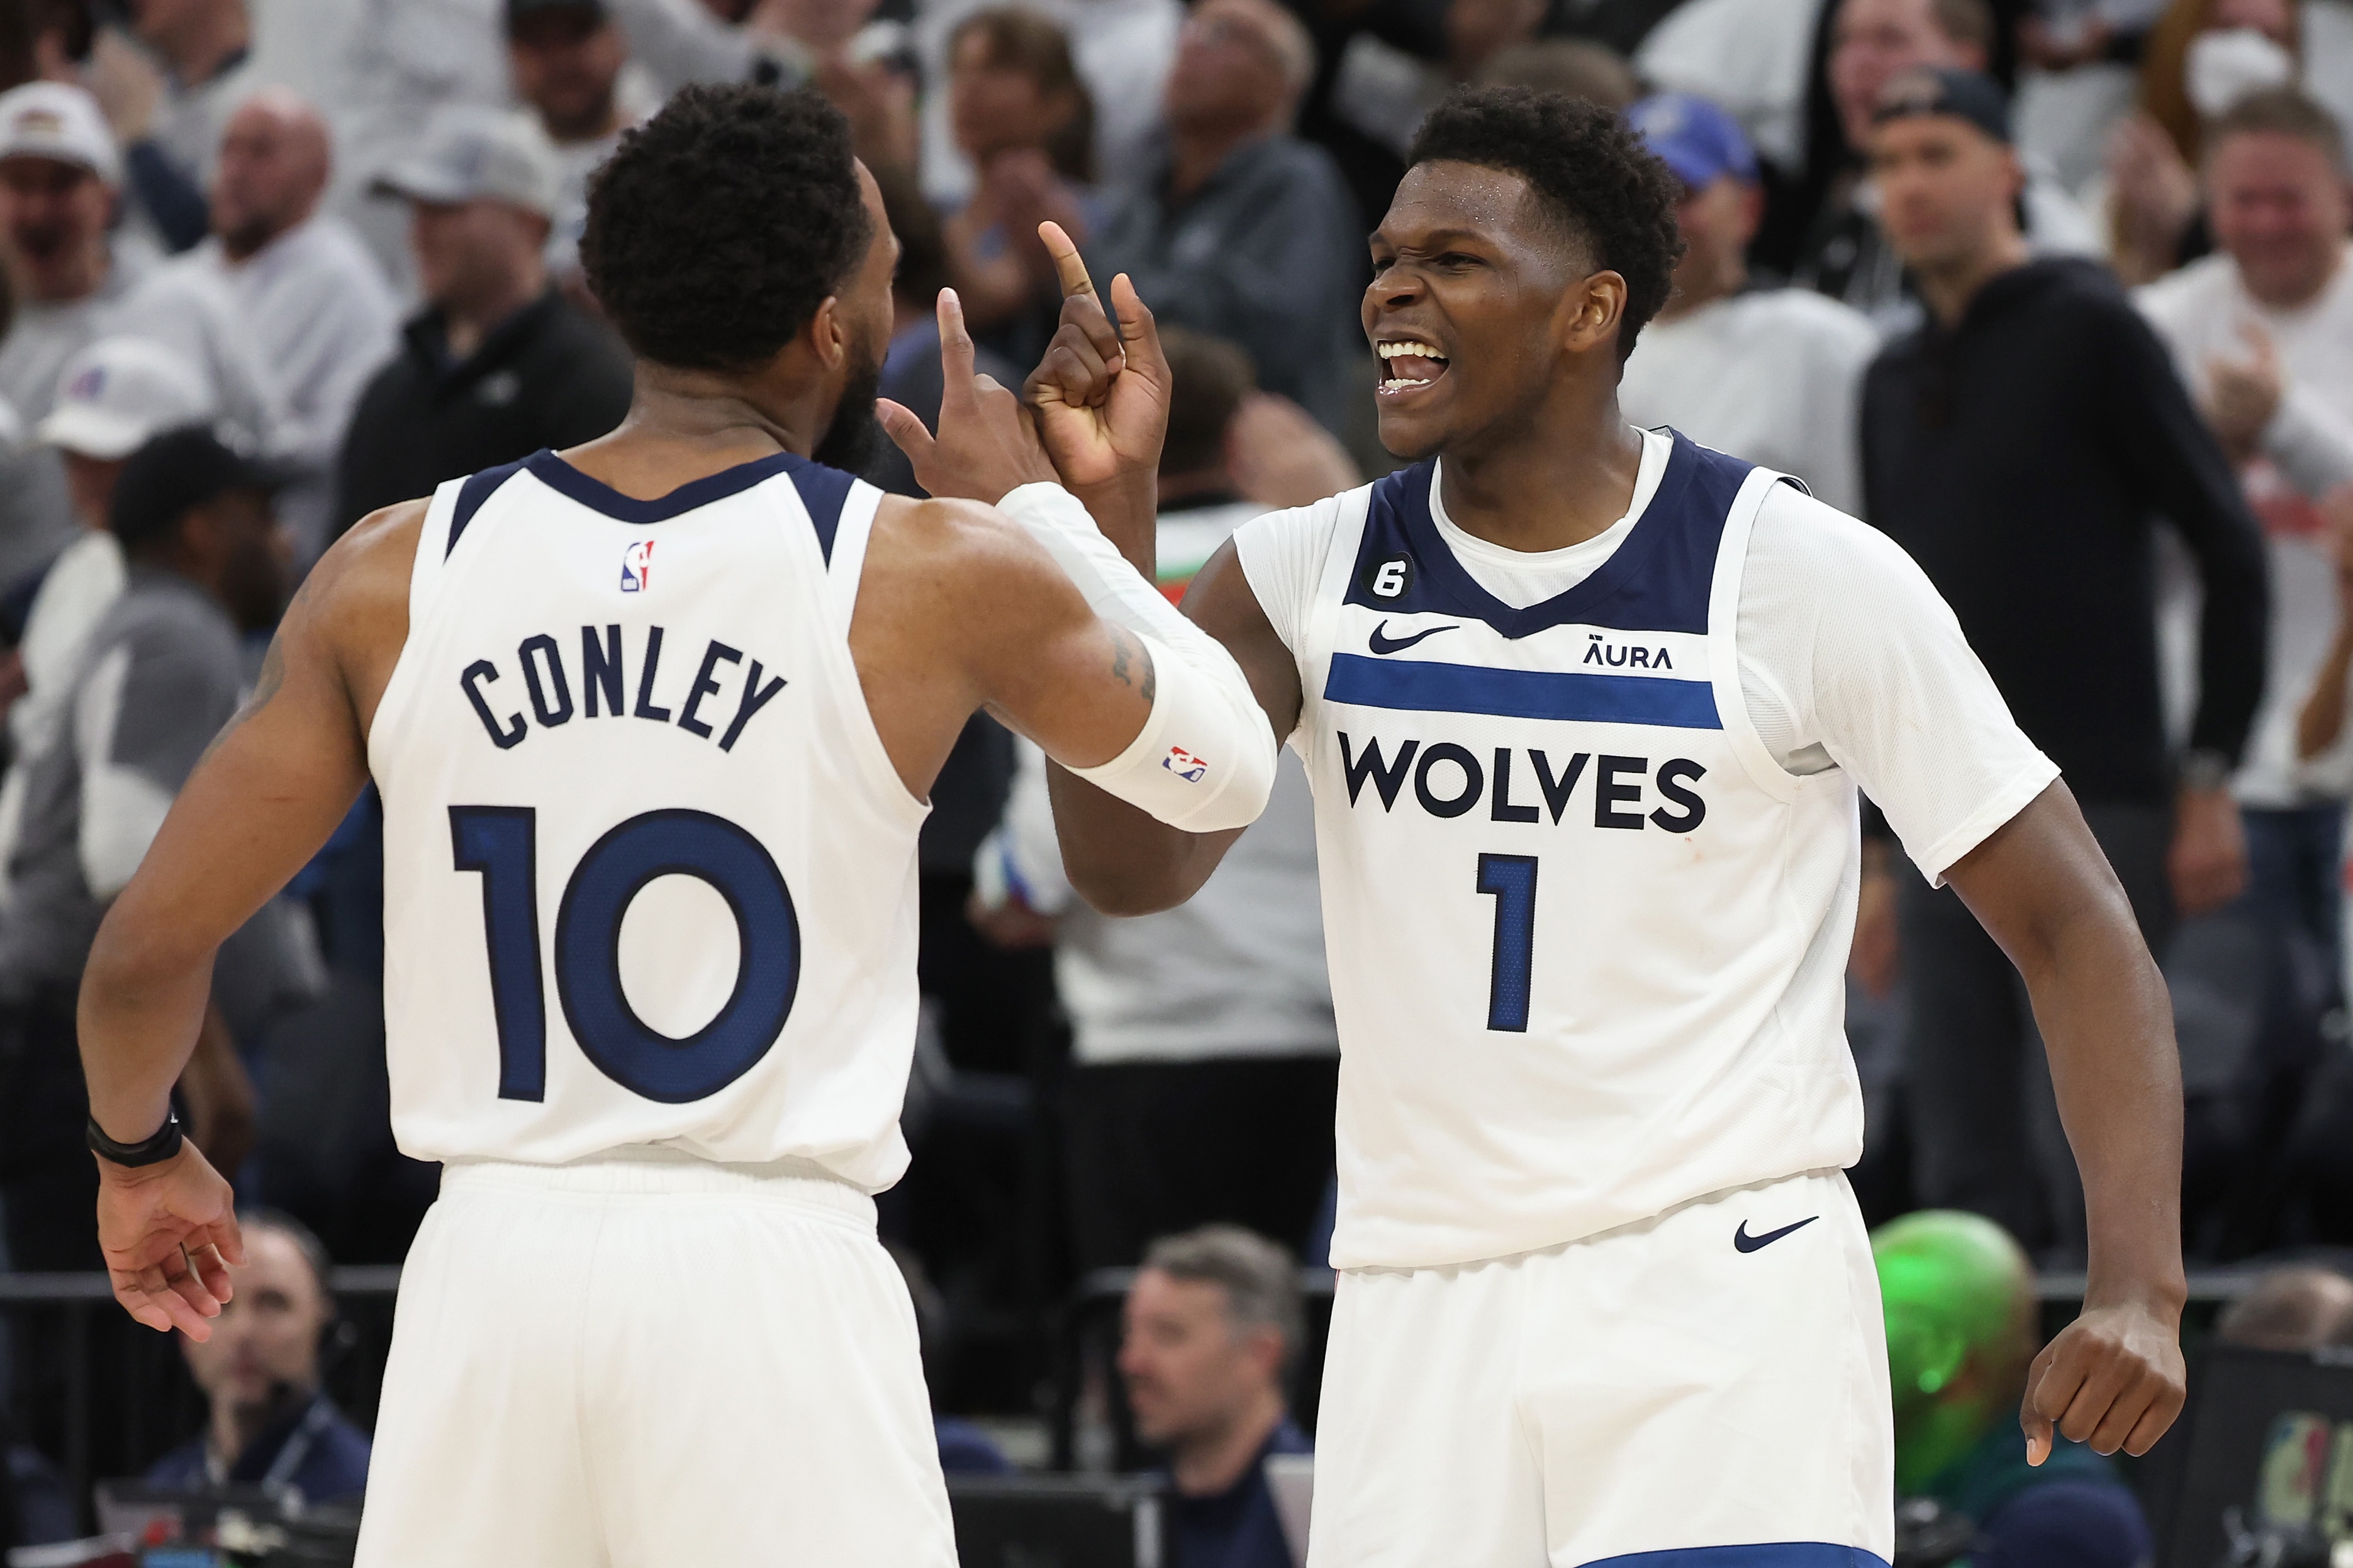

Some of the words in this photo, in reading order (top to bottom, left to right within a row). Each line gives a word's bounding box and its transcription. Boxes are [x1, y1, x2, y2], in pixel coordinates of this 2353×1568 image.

[1373, 560, 1406, 598] 6
[461, 624, 787, 753] CONLEY
[1337, 731, 1707, 833] WOLVES
[448, 805, 801, 1104] 10
[1476, 853, 1539, 1033] 1
